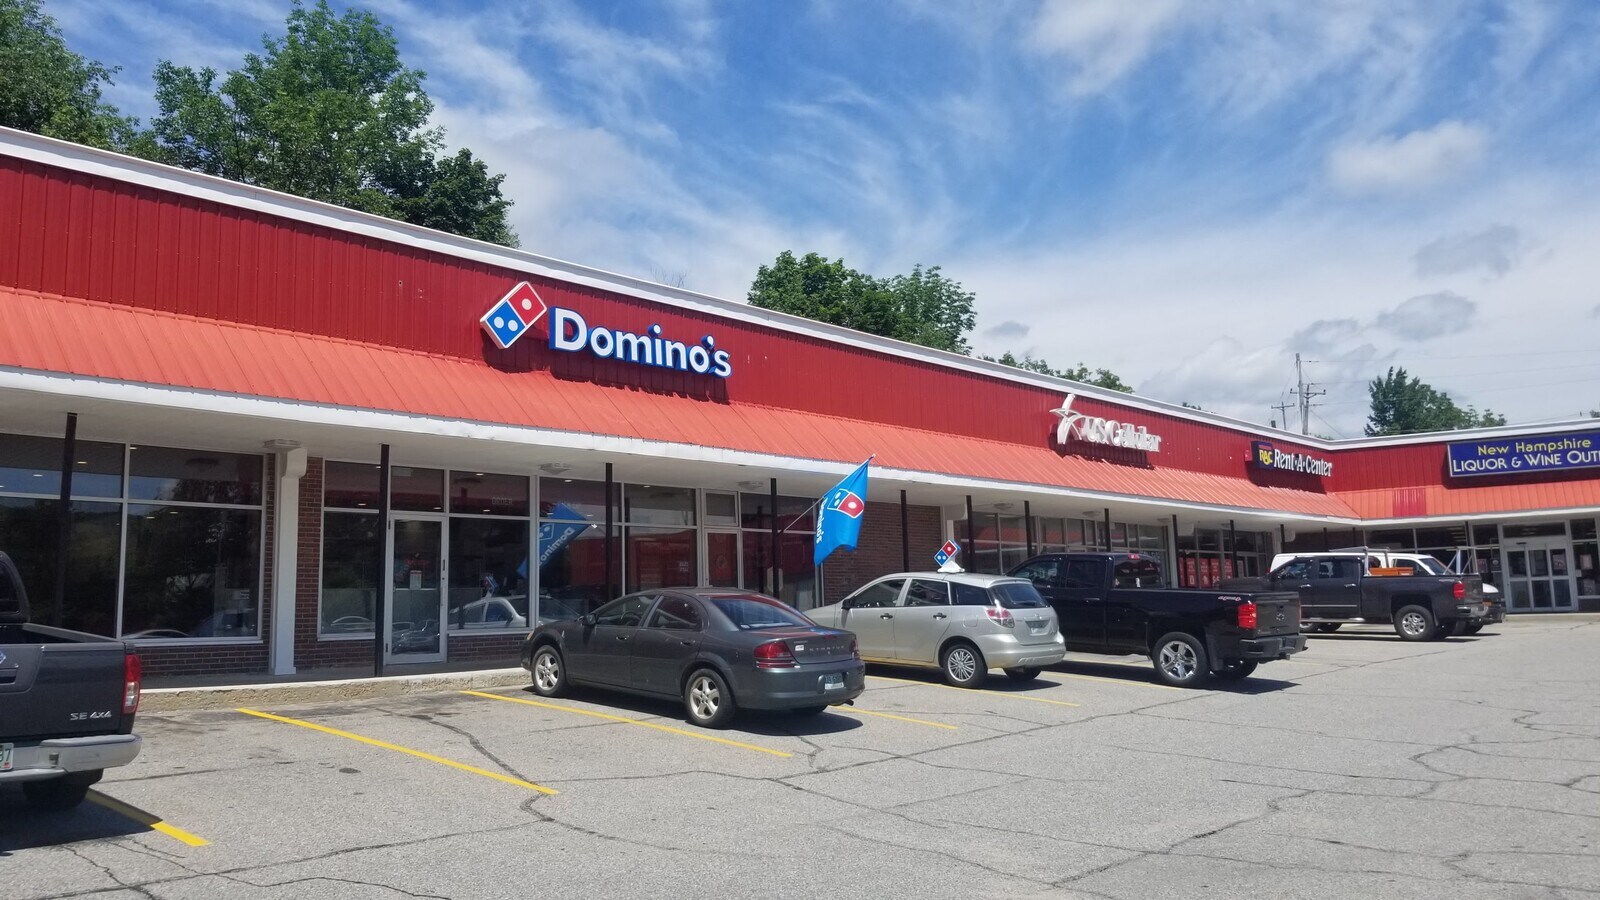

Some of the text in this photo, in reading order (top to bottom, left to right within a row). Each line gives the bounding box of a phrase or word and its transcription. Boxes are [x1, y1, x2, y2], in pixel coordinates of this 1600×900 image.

[550, 306, 732, 378] Domino's
[1477, 438, 1592, 456] New Hampshire
[1452, 450, 1600, 472] LIQUOR & WINE OUT
[70, 712, 88, 721] SE
